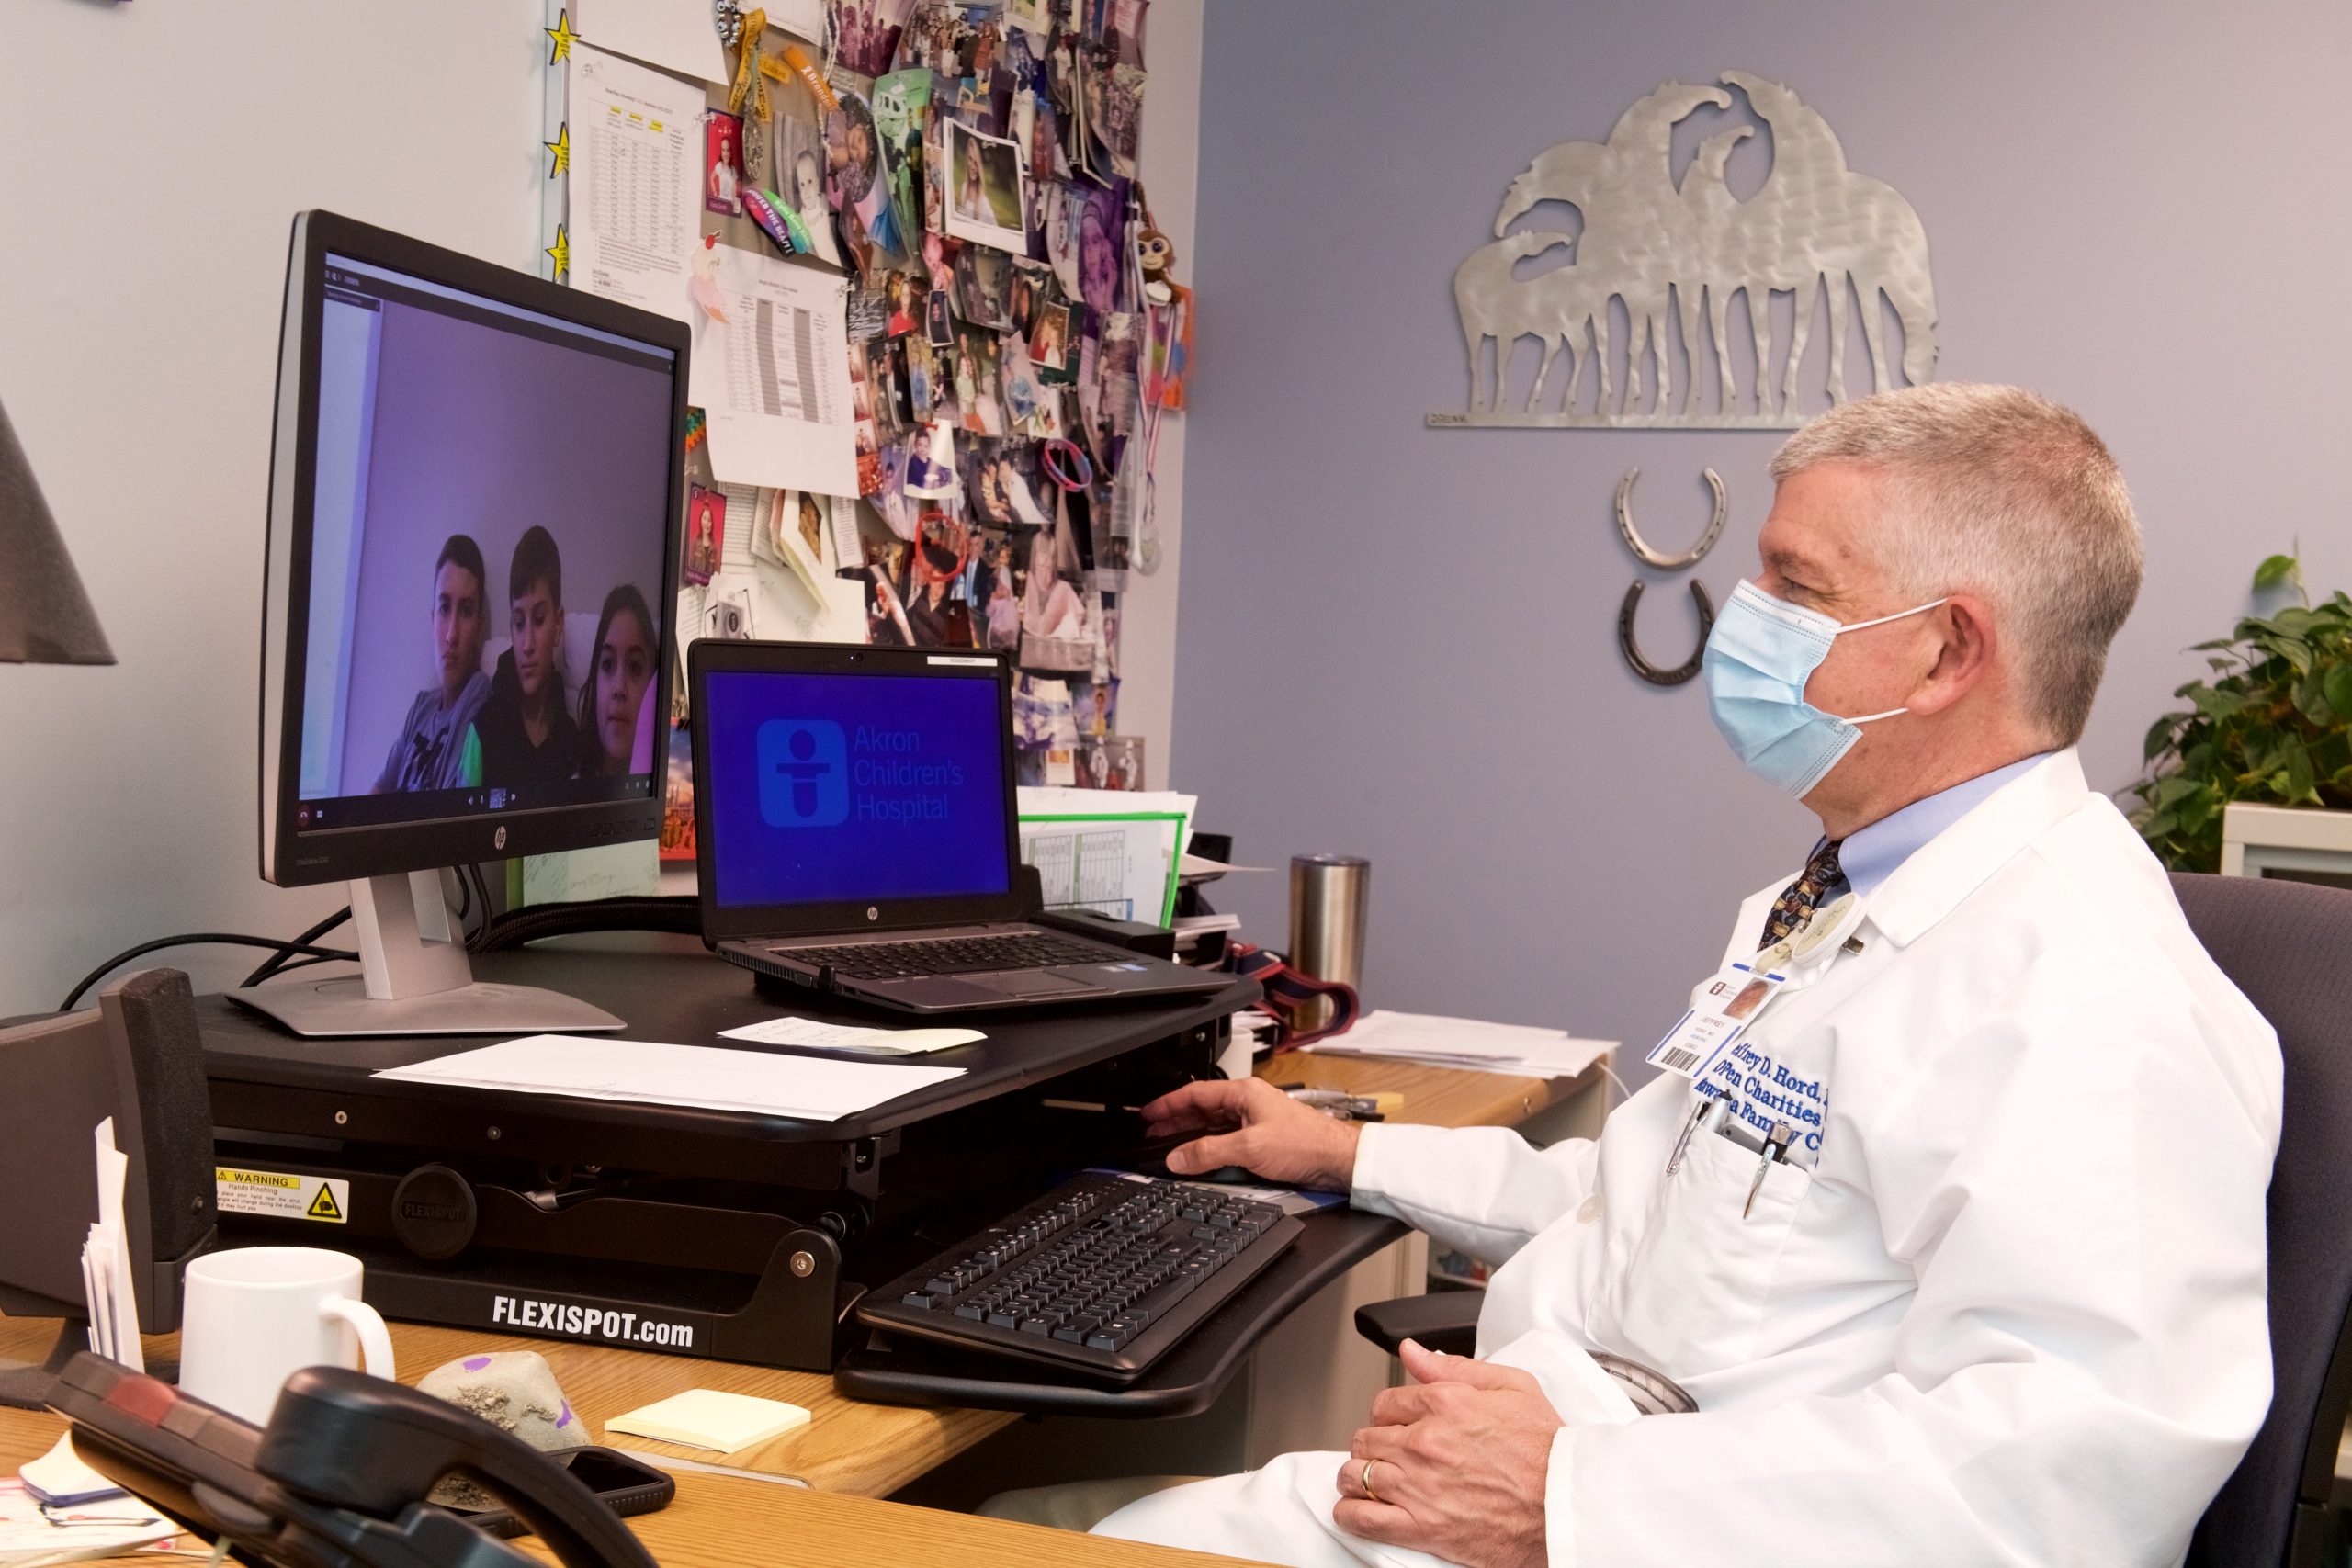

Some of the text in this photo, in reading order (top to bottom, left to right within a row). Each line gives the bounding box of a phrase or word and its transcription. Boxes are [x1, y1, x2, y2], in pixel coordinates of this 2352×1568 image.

[854, 725, 920, 752] Akron
[854, 759, 964, 787] Children's
[856, 793, 949, 826] Hospital
[1731, 1043, 1822, 1103] effrey D. Hord,
[1712, 1059, 1743, 1088] OPen
[1744, 1076, 1822, 1127] Charities
[1739, 1101, 1804, 1146] Famy
[228, 1183, 278, 1196] Hands Pinching
[234, 1172, 288, 1187] WARNING
[404, 1202, 463, 1221] FLEXISPOT
[492, 1295, 694, 1348] FLEXISPOT.com
